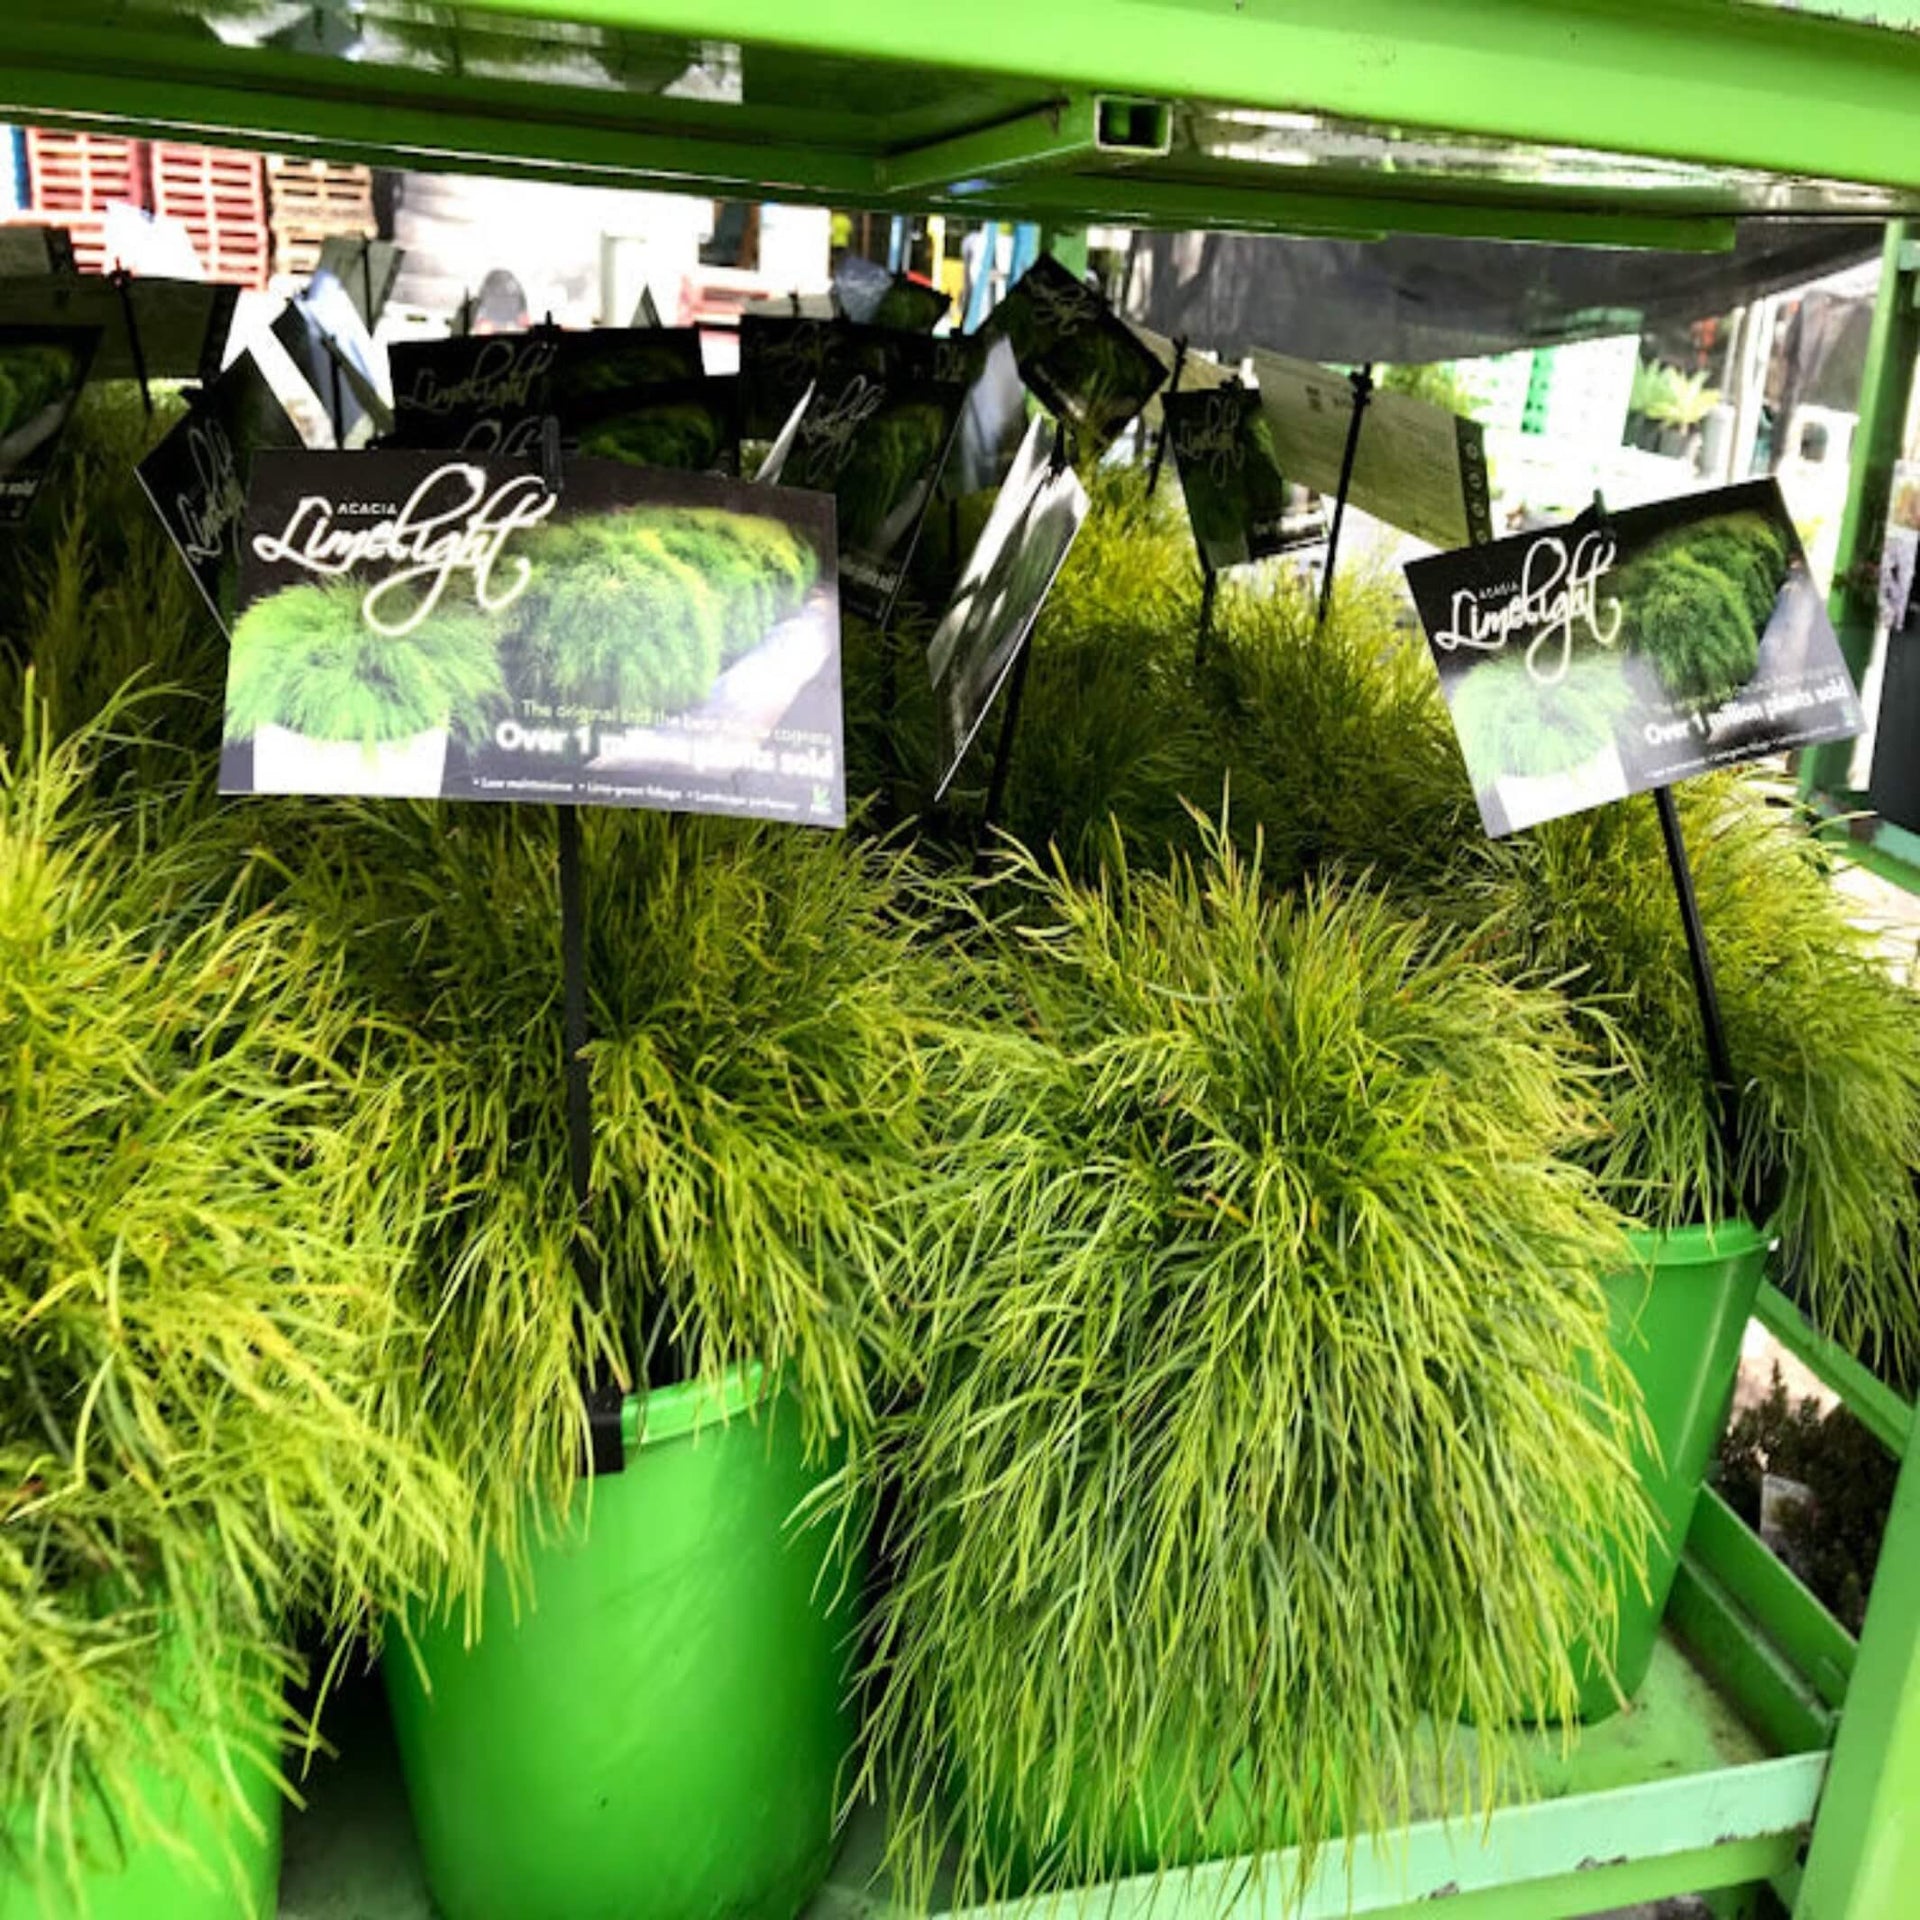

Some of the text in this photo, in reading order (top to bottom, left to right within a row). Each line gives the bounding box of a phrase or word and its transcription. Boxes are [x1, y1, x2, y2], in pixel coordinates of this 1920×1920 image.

[336, 501, 398, 516] ACACIA
[252, 462, 558, 637] Limelight
[1434, 530, 1622, 684] Limelight
[522, 699, 553, 718] The
[1644, 720, 1690, 746] Over
[1691, 710, 1705, 733] 1
[1814, 675, 1850, 704] sold
[495, 719, 568, 754] Over
[574, 724, 591, 755] 1
